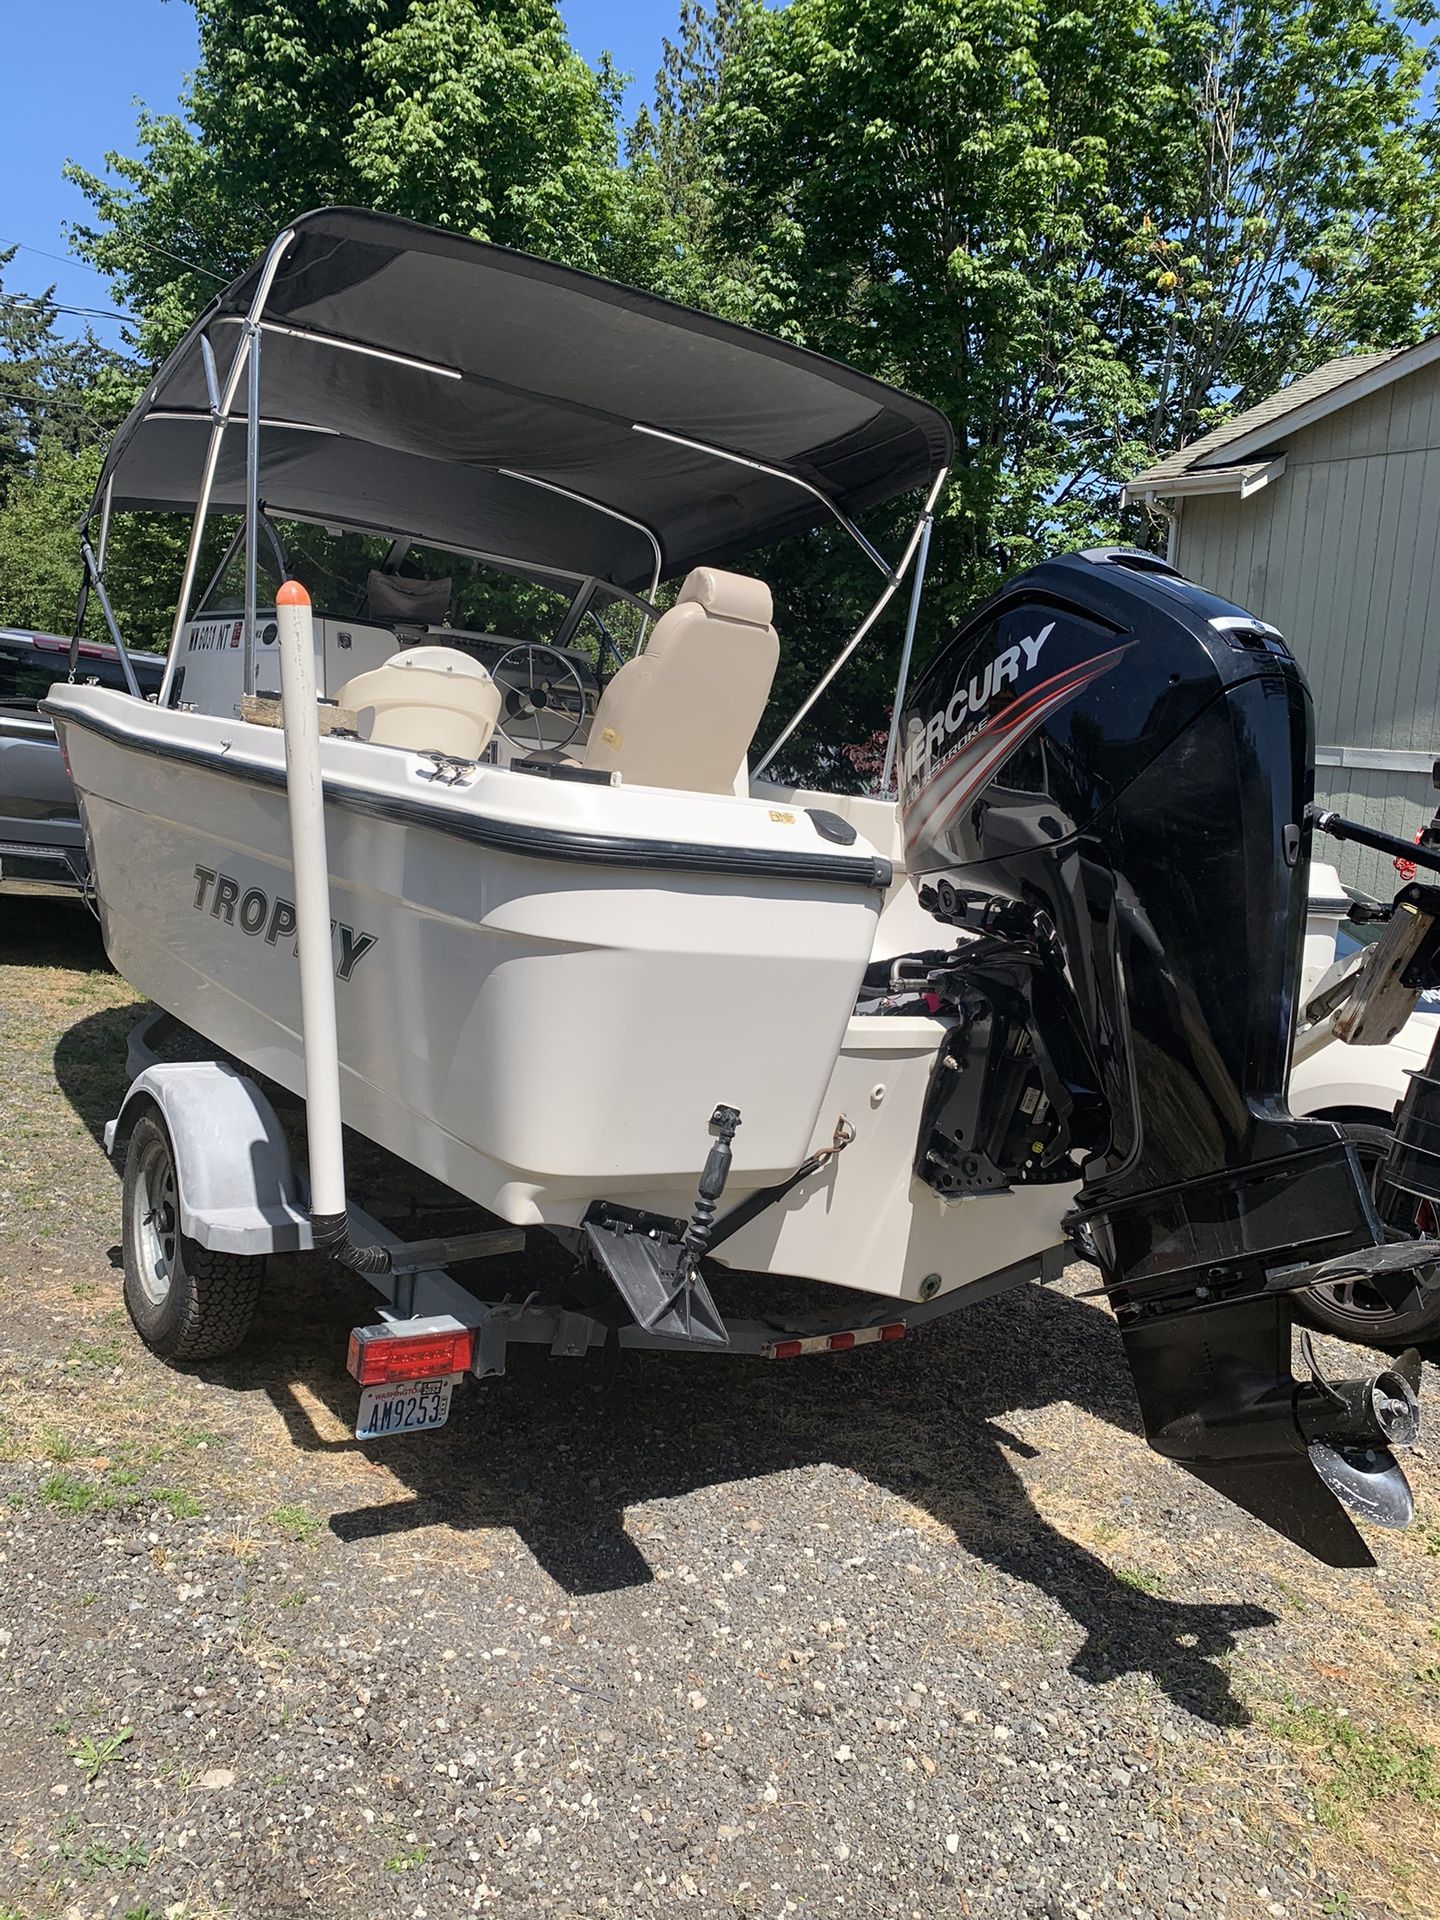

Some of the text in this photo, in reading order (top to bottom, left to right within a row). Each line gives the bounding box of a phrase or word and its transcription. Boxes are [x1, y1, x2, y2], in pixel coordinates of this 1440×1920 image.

[899, 621, 1057, 791] MERCURY
[193, 863, 379, 983] TROPY
[368, 1394, 441, 1433] AM9253
